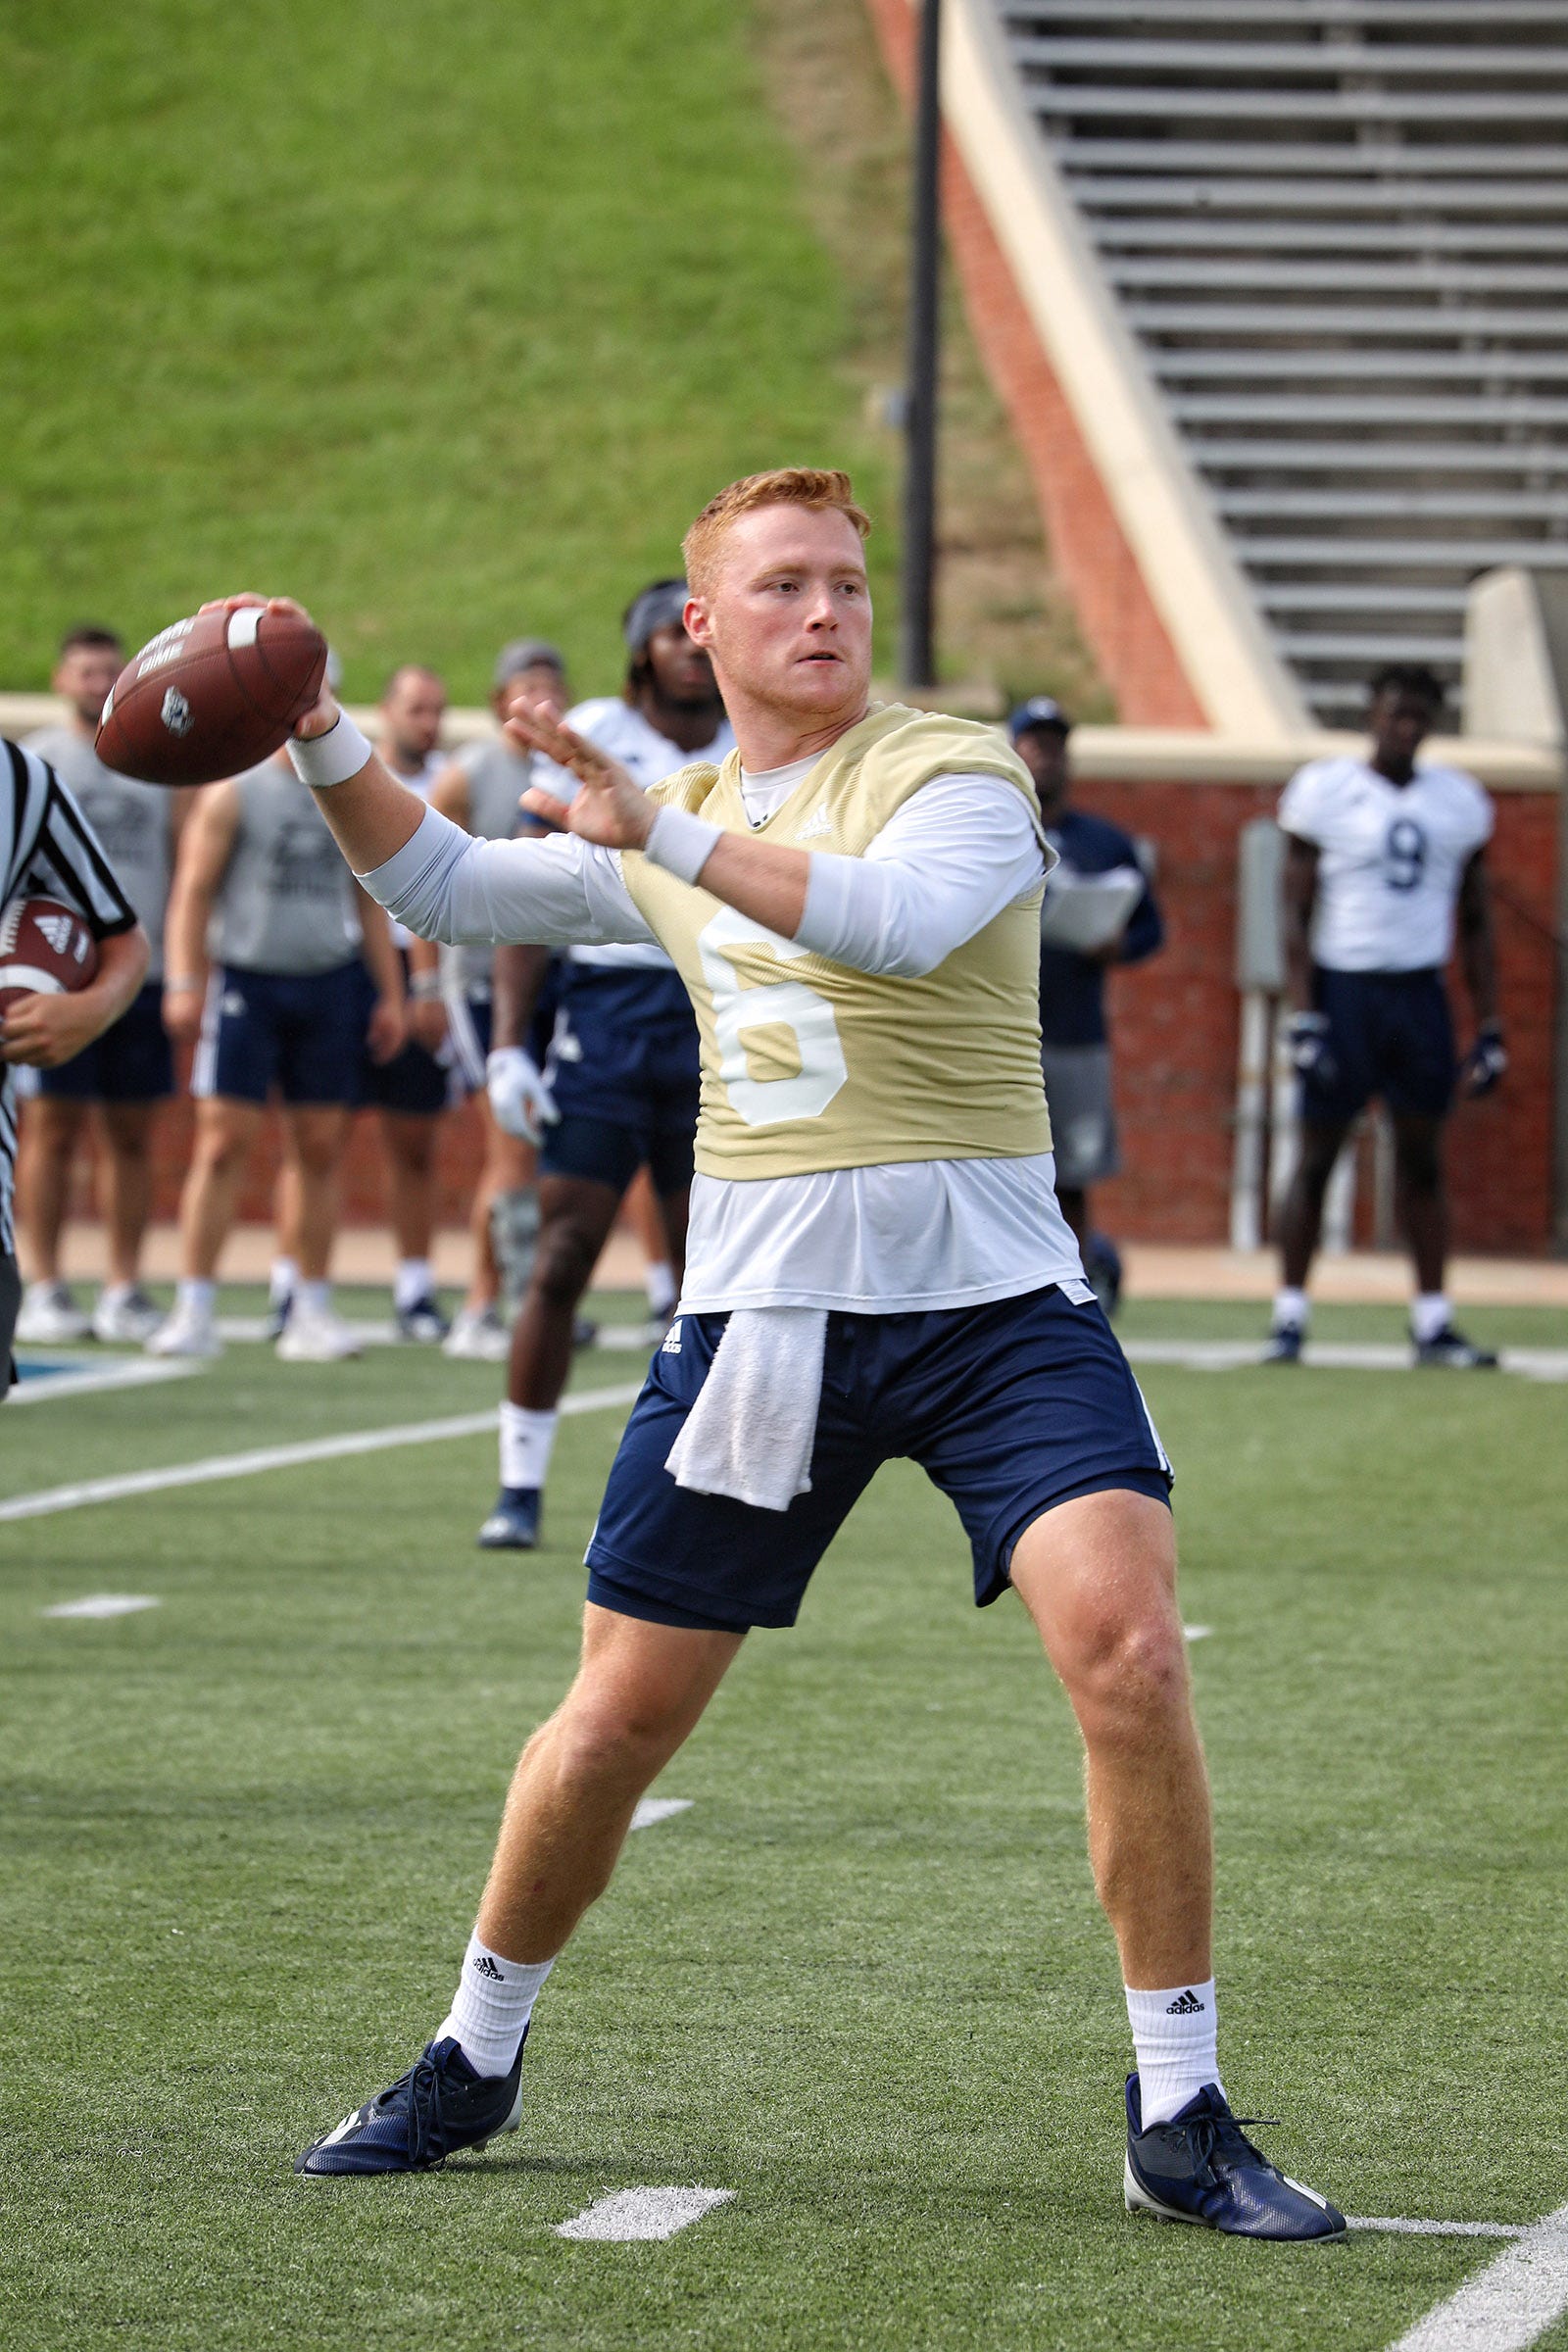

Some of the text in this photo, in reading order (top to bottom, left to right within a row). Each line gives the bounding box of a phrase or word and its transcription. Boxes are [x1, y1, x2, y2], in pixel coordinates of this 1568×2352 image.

[1388, 819, 1427, 892] 9
[697, 906, 849, 1127] 6
[472, 1958, 504, 1982] adidas
[1166, 2002, 1205, 2015] adidas
